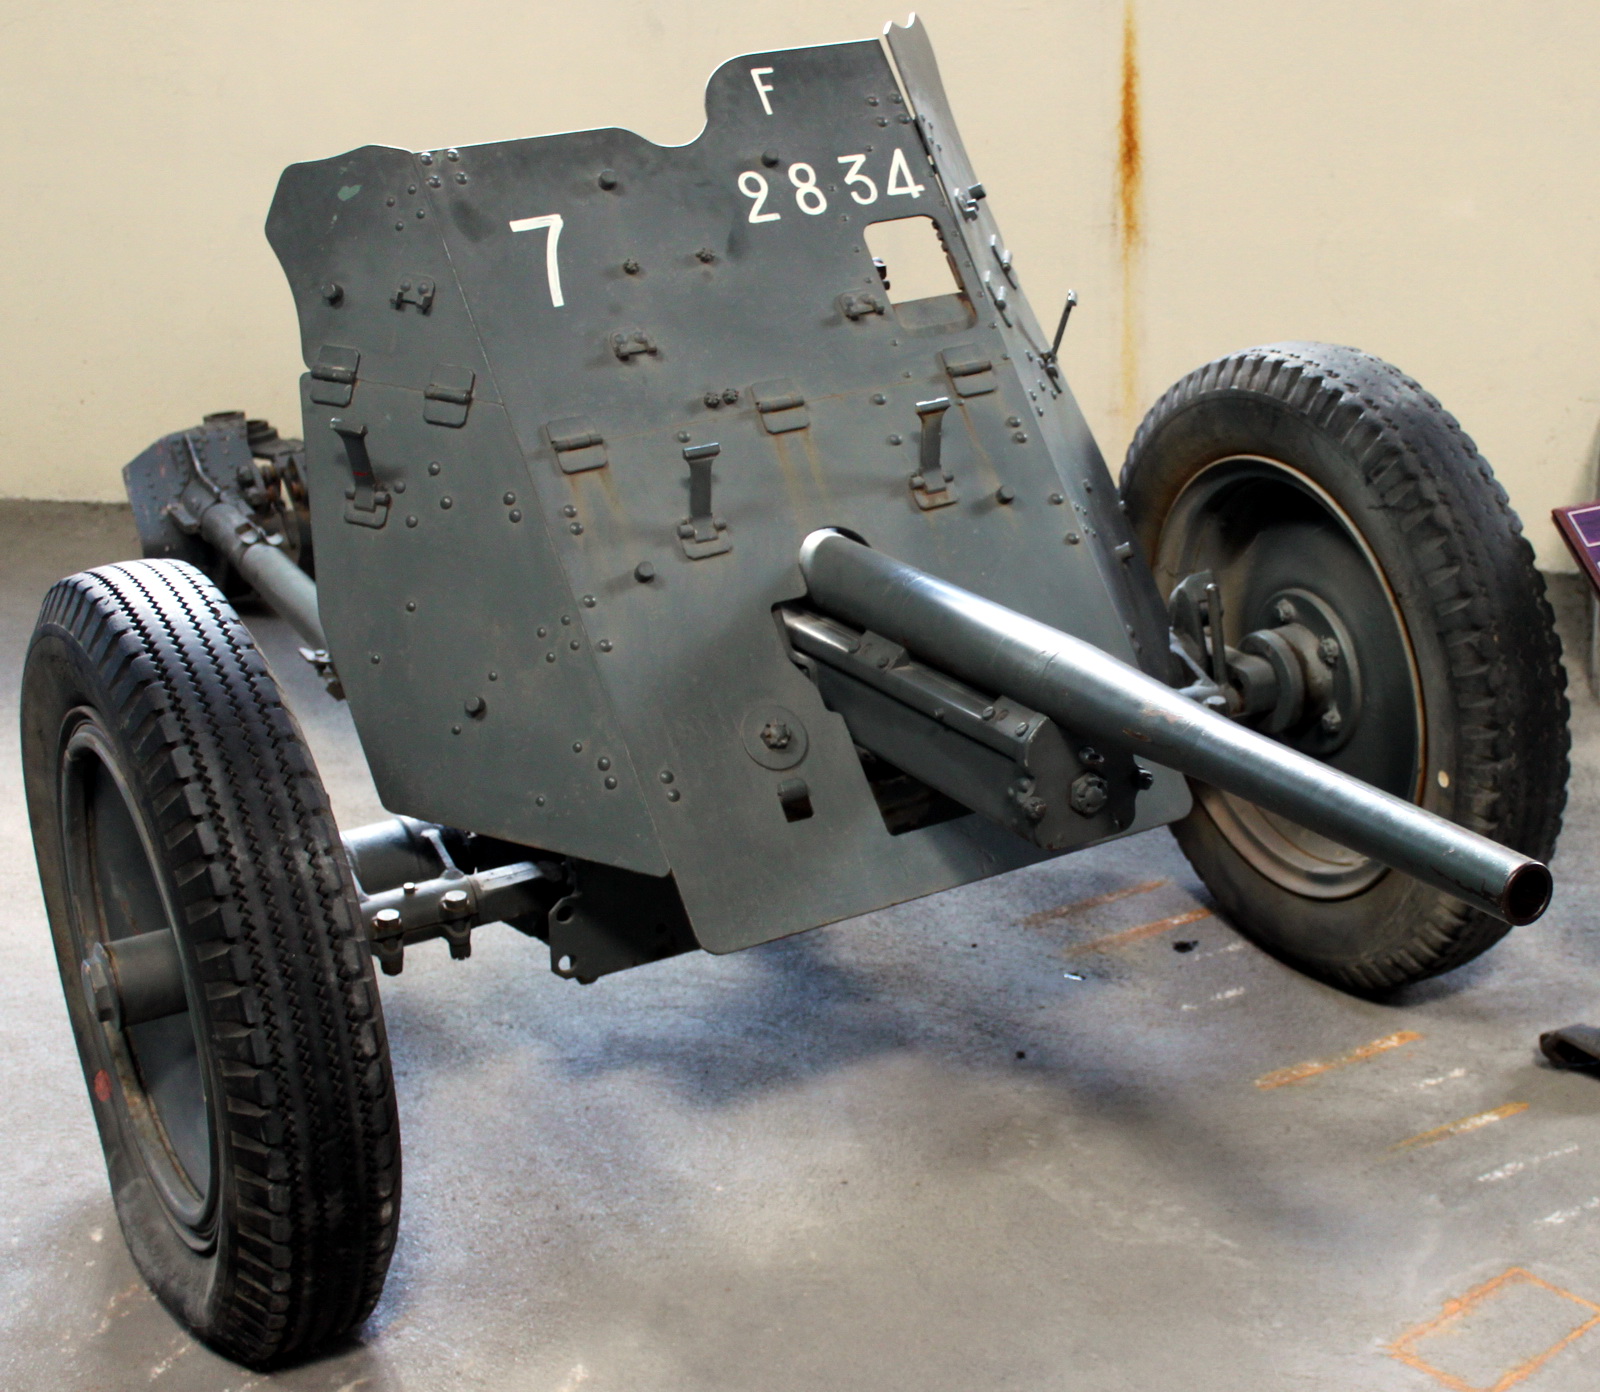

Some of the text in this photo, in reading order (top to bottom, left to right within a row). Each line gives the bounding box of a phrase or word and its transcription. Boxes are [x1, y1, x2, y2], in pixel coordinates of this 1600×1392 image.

[750, 67, 774, 116] F
[737, 147, 926, 224] 2834
[508, 213, 565, 308] 7
